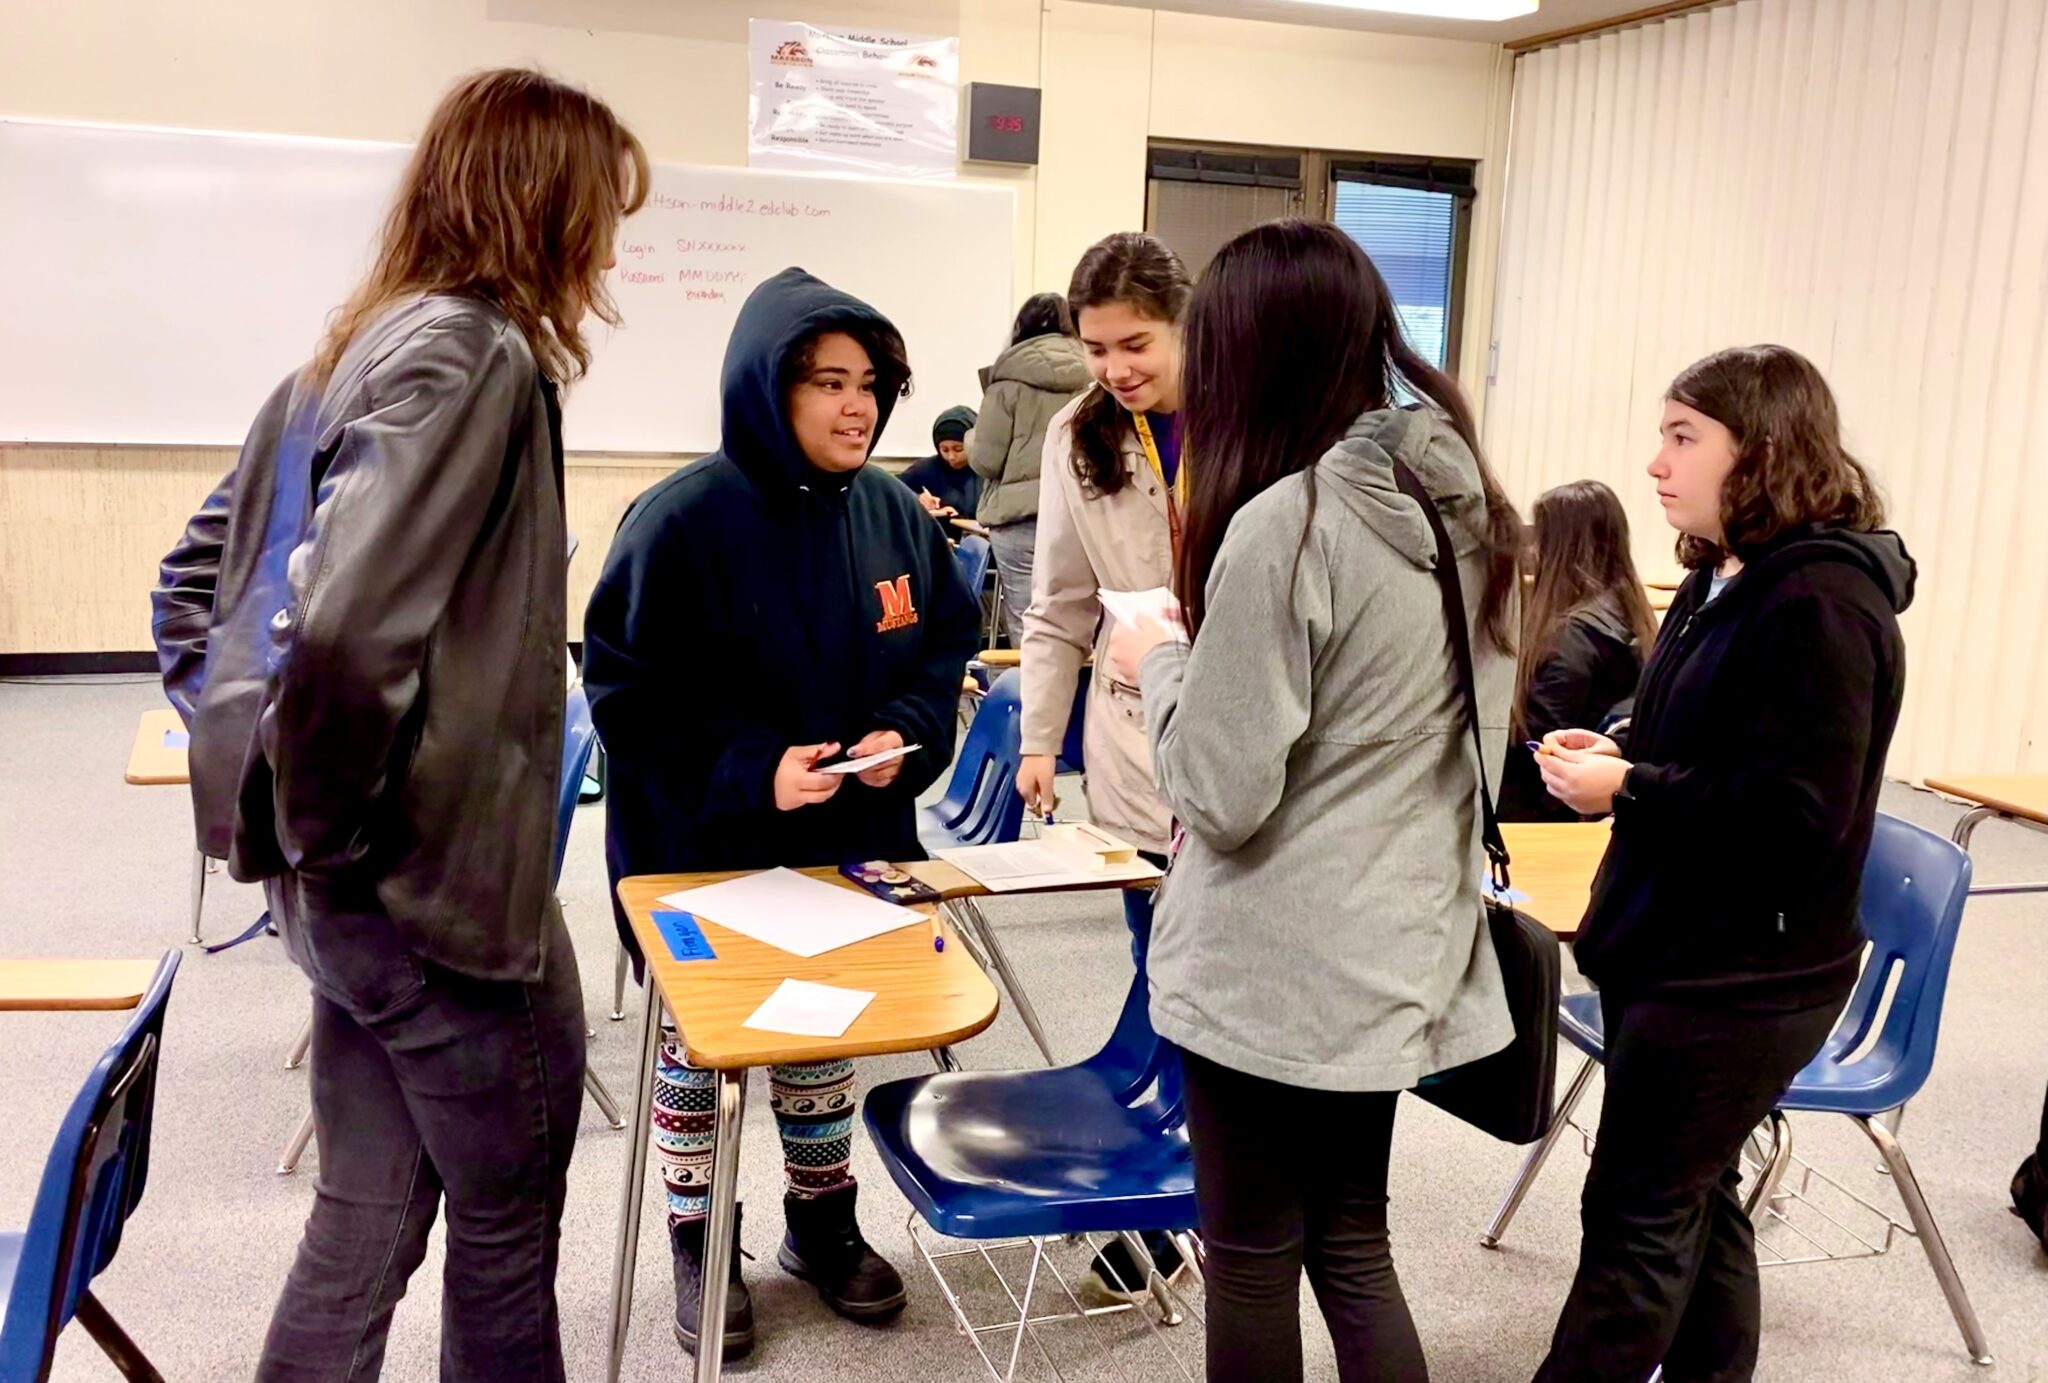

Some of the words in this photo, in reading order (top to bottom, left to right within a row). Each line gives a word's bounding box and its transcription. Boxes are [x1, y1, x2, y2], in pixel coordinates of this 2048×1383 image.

[847, 33, 876, 44] Middle
[879, 36, 909, 47] School
[874, 573, 915, 616] M
